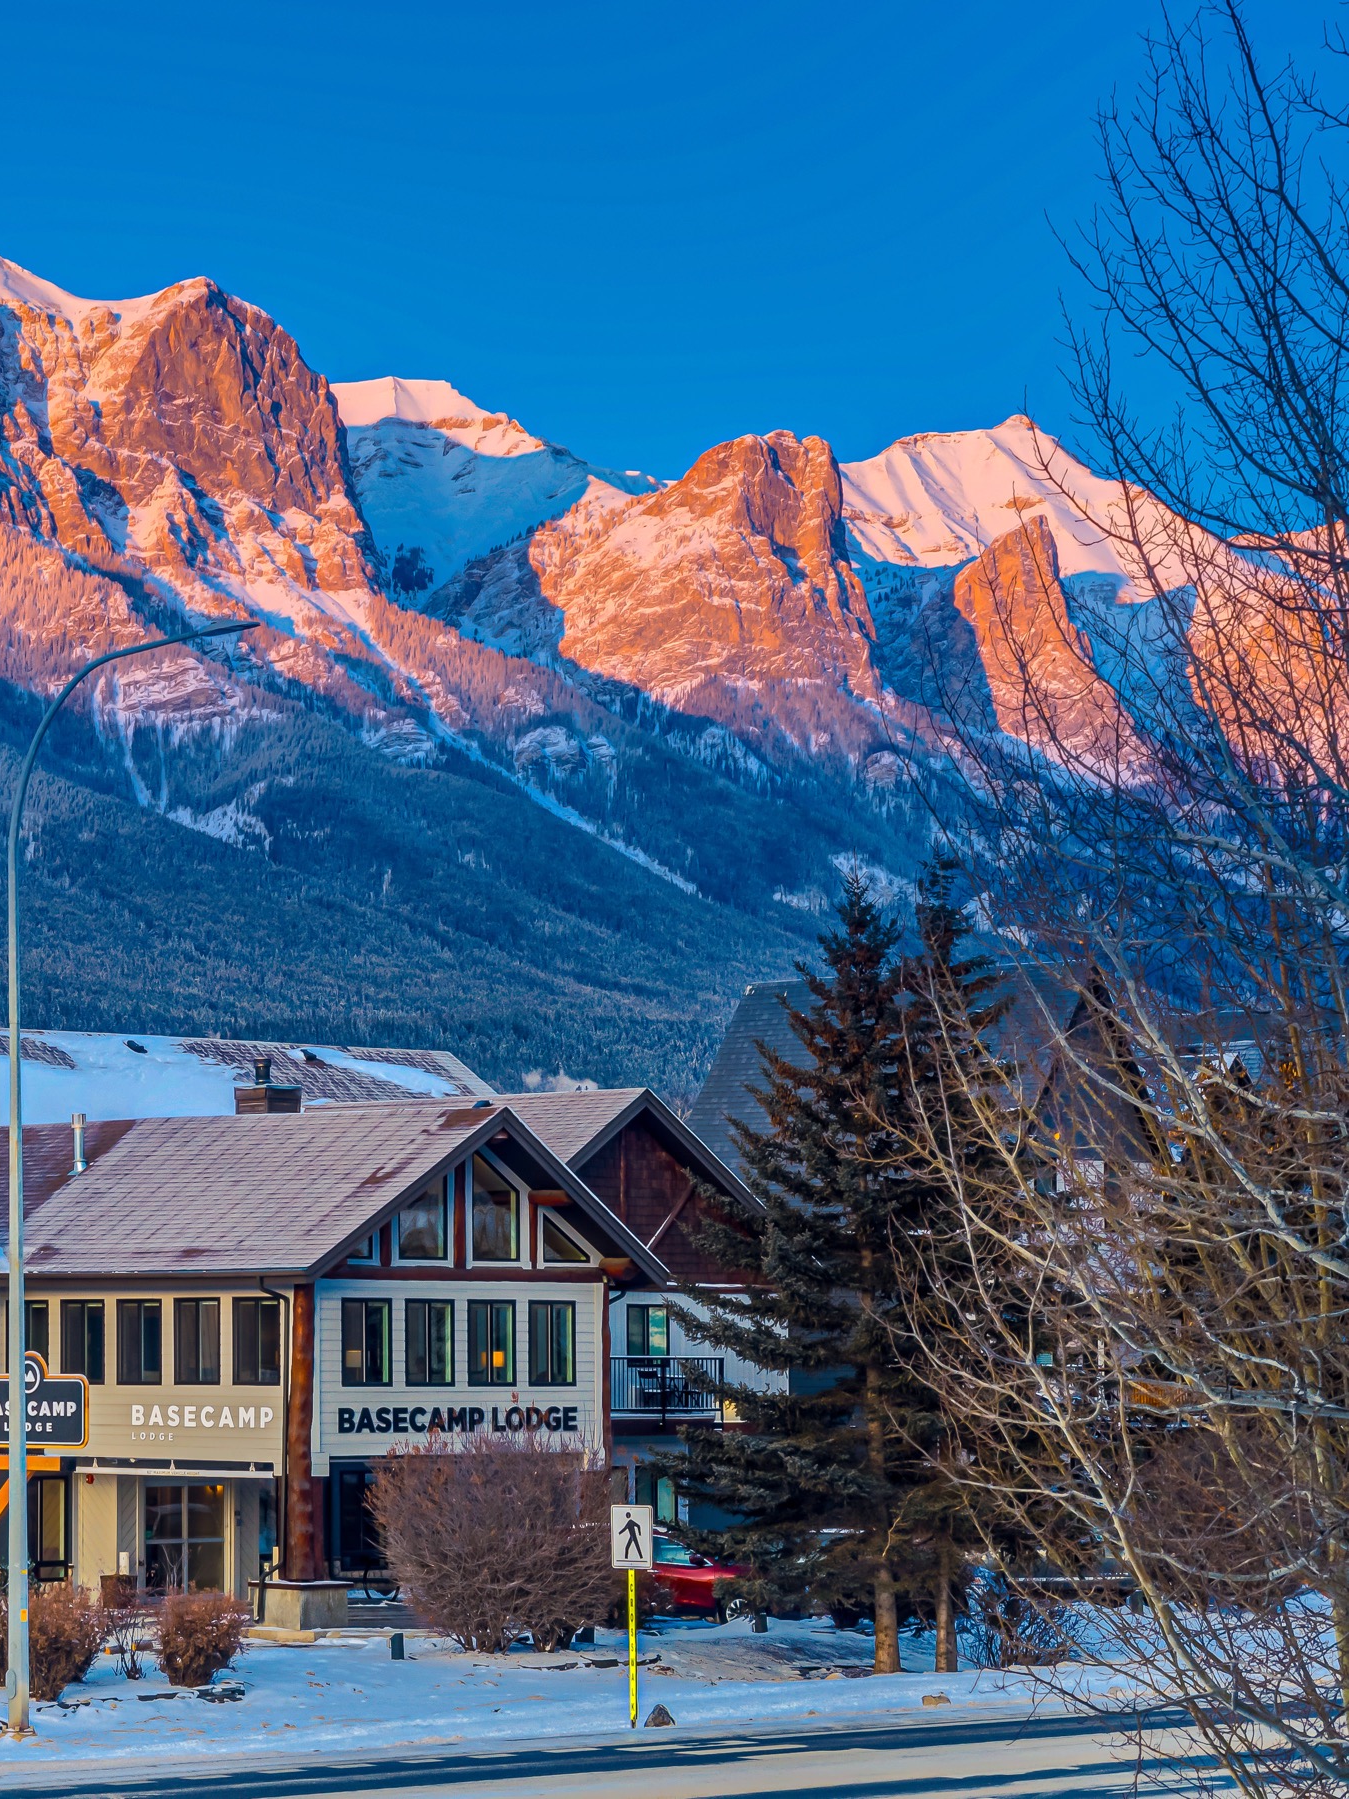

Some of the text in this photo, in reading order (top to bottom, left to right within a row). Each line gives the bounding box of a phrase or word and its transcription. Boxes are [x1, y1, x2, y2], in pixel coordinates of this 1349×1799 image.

[131, 1404, 274, 1428] BASECAMP
[338, 1406, 578, 1434] BASECAMP LODGE
[4, 1422, 53, 1432] LDGE
[131, 1432, 174, 1441] LODGE
